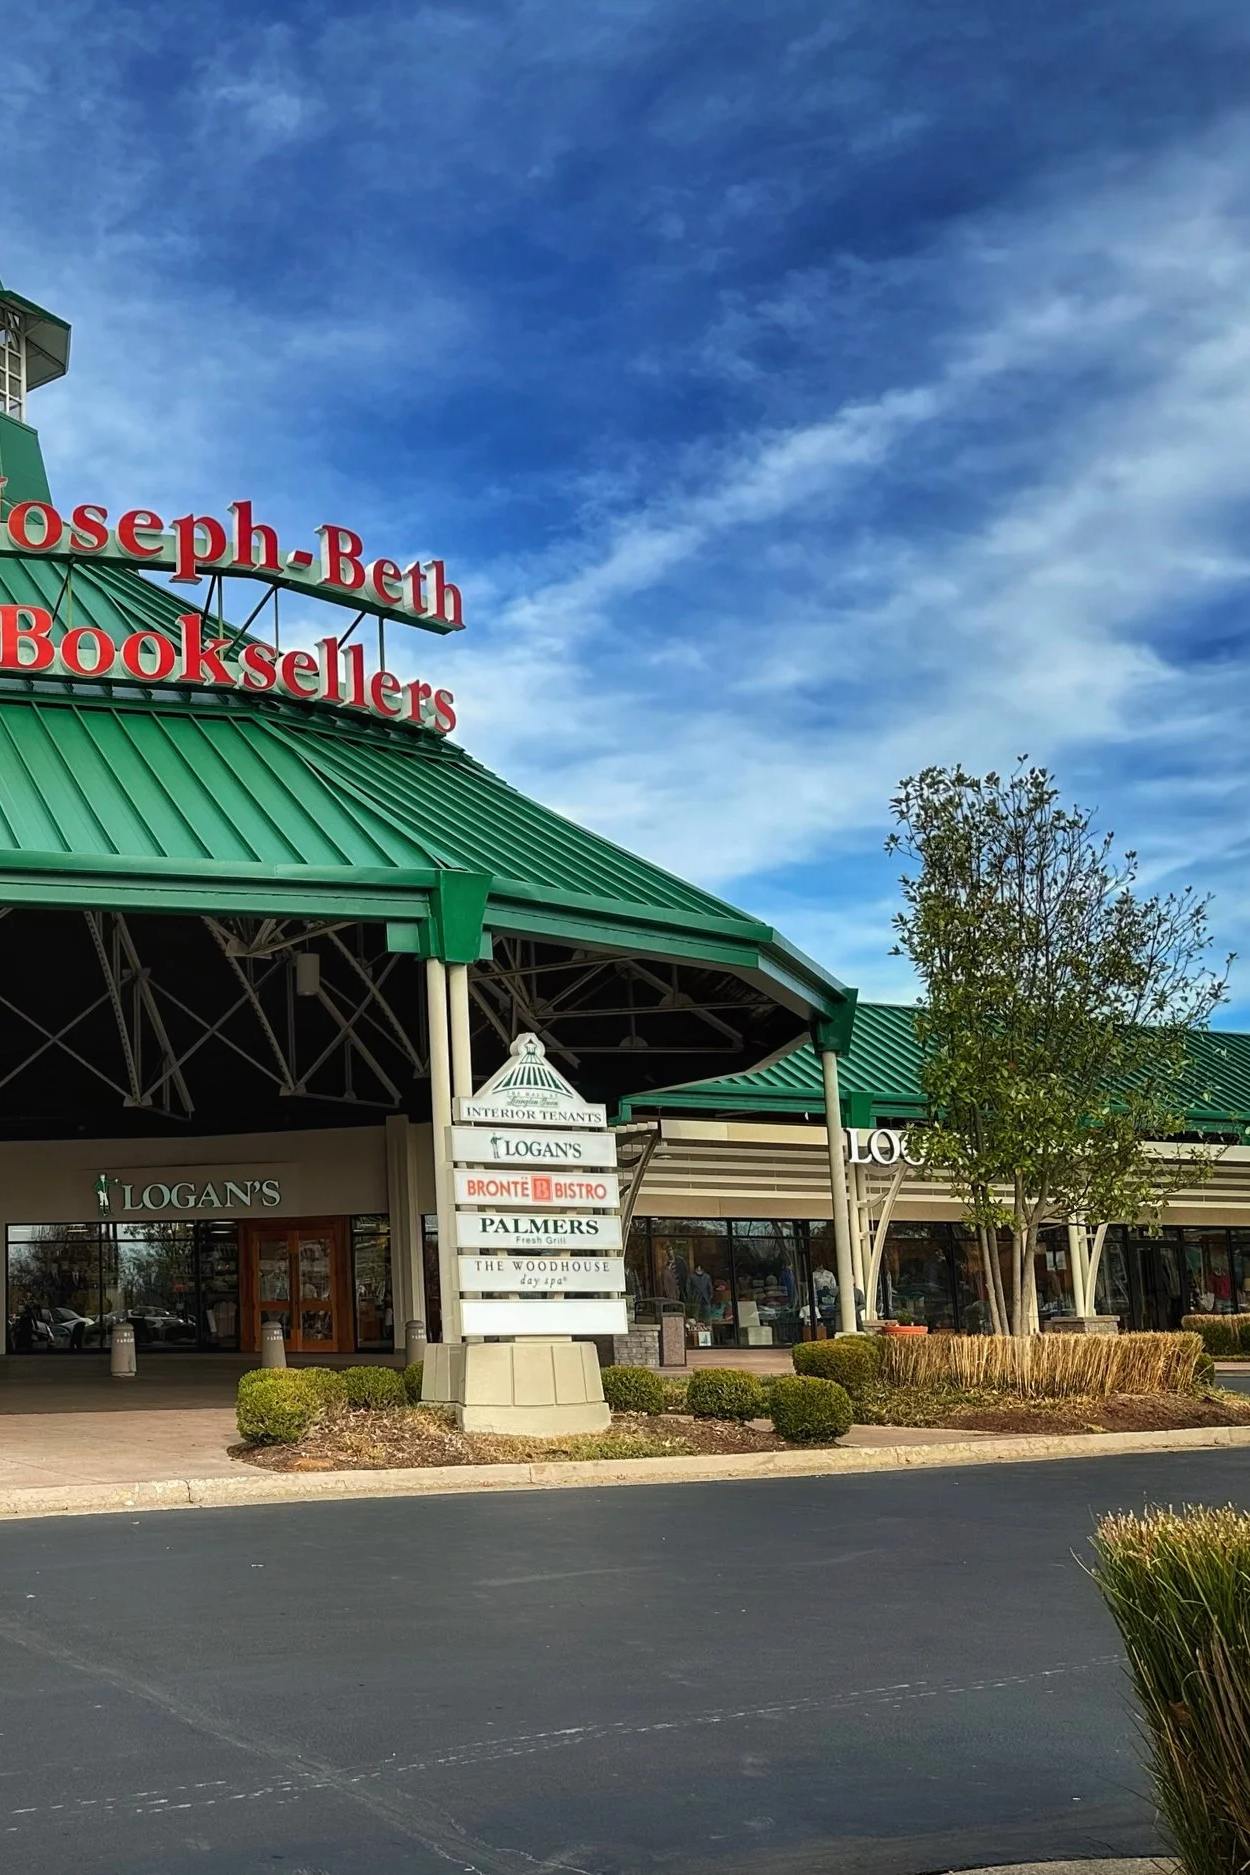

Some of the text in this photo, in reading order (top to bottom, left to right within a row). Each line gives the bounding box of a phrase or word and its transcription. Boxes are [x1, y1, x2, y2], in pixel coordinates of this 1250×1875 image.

[467, 1107, 602, 1123] INTERIOR TENANTS
[505, 1140, 582, 1159] LOGAN'S
[122, 1179, 281, 1210] LOGAN'S
[467, 1176, 530, 1198] BRONTË
[555, 1182, 607, 1200] BISTRO
[480, 1217, 599, 1235] PALMERS
[516, 1235, 567, 1246] Fresh Grill
[475, 1260, 610, 1273] THE WOODHOUSE
[520, 1274, 540, 1287] day
